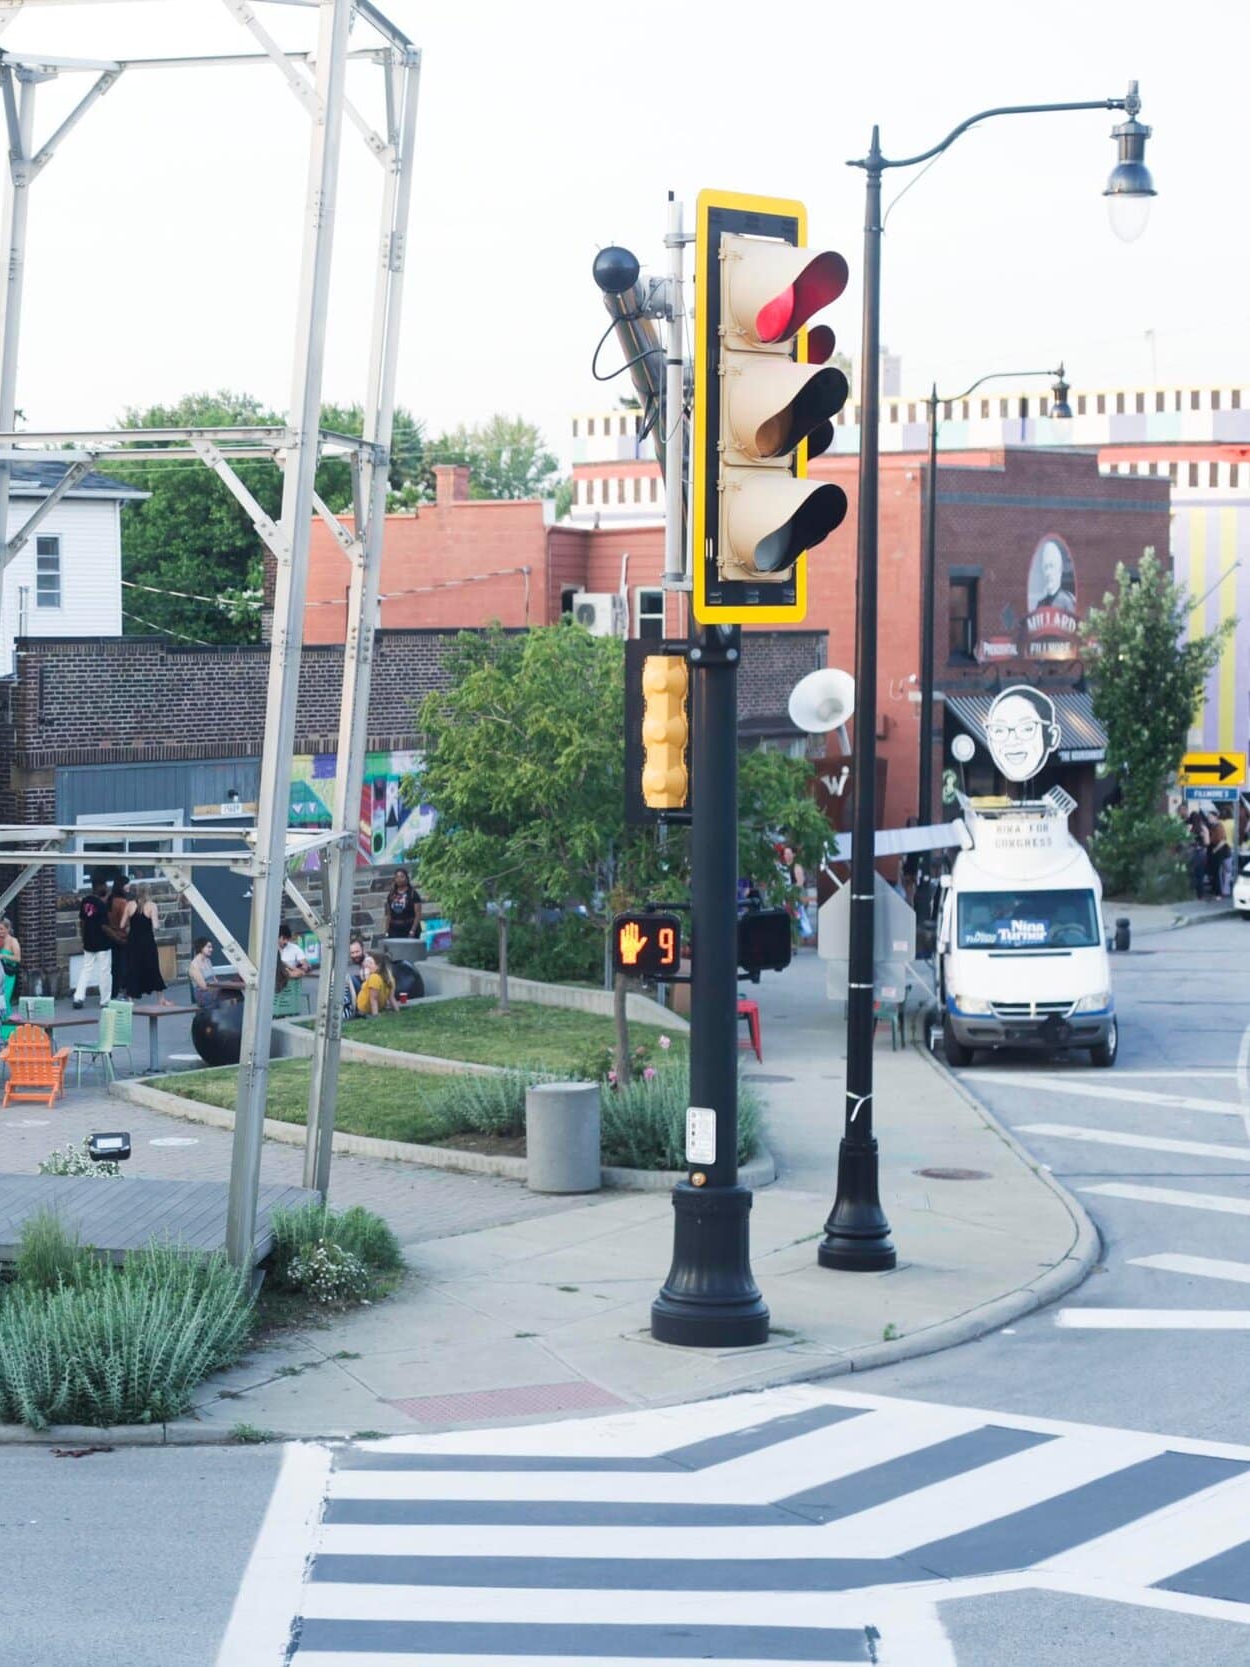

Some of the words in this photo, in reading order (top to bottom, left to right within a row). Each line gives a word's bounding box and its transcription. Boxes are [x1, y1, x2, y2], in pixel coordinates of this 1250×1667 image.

[1027, 612, 1076, 633] MILLARD
[997, 928, 1048, 941] Turner
[1011, 919, 1045, 933] Nina
[658, 927, 674, 964] 9
